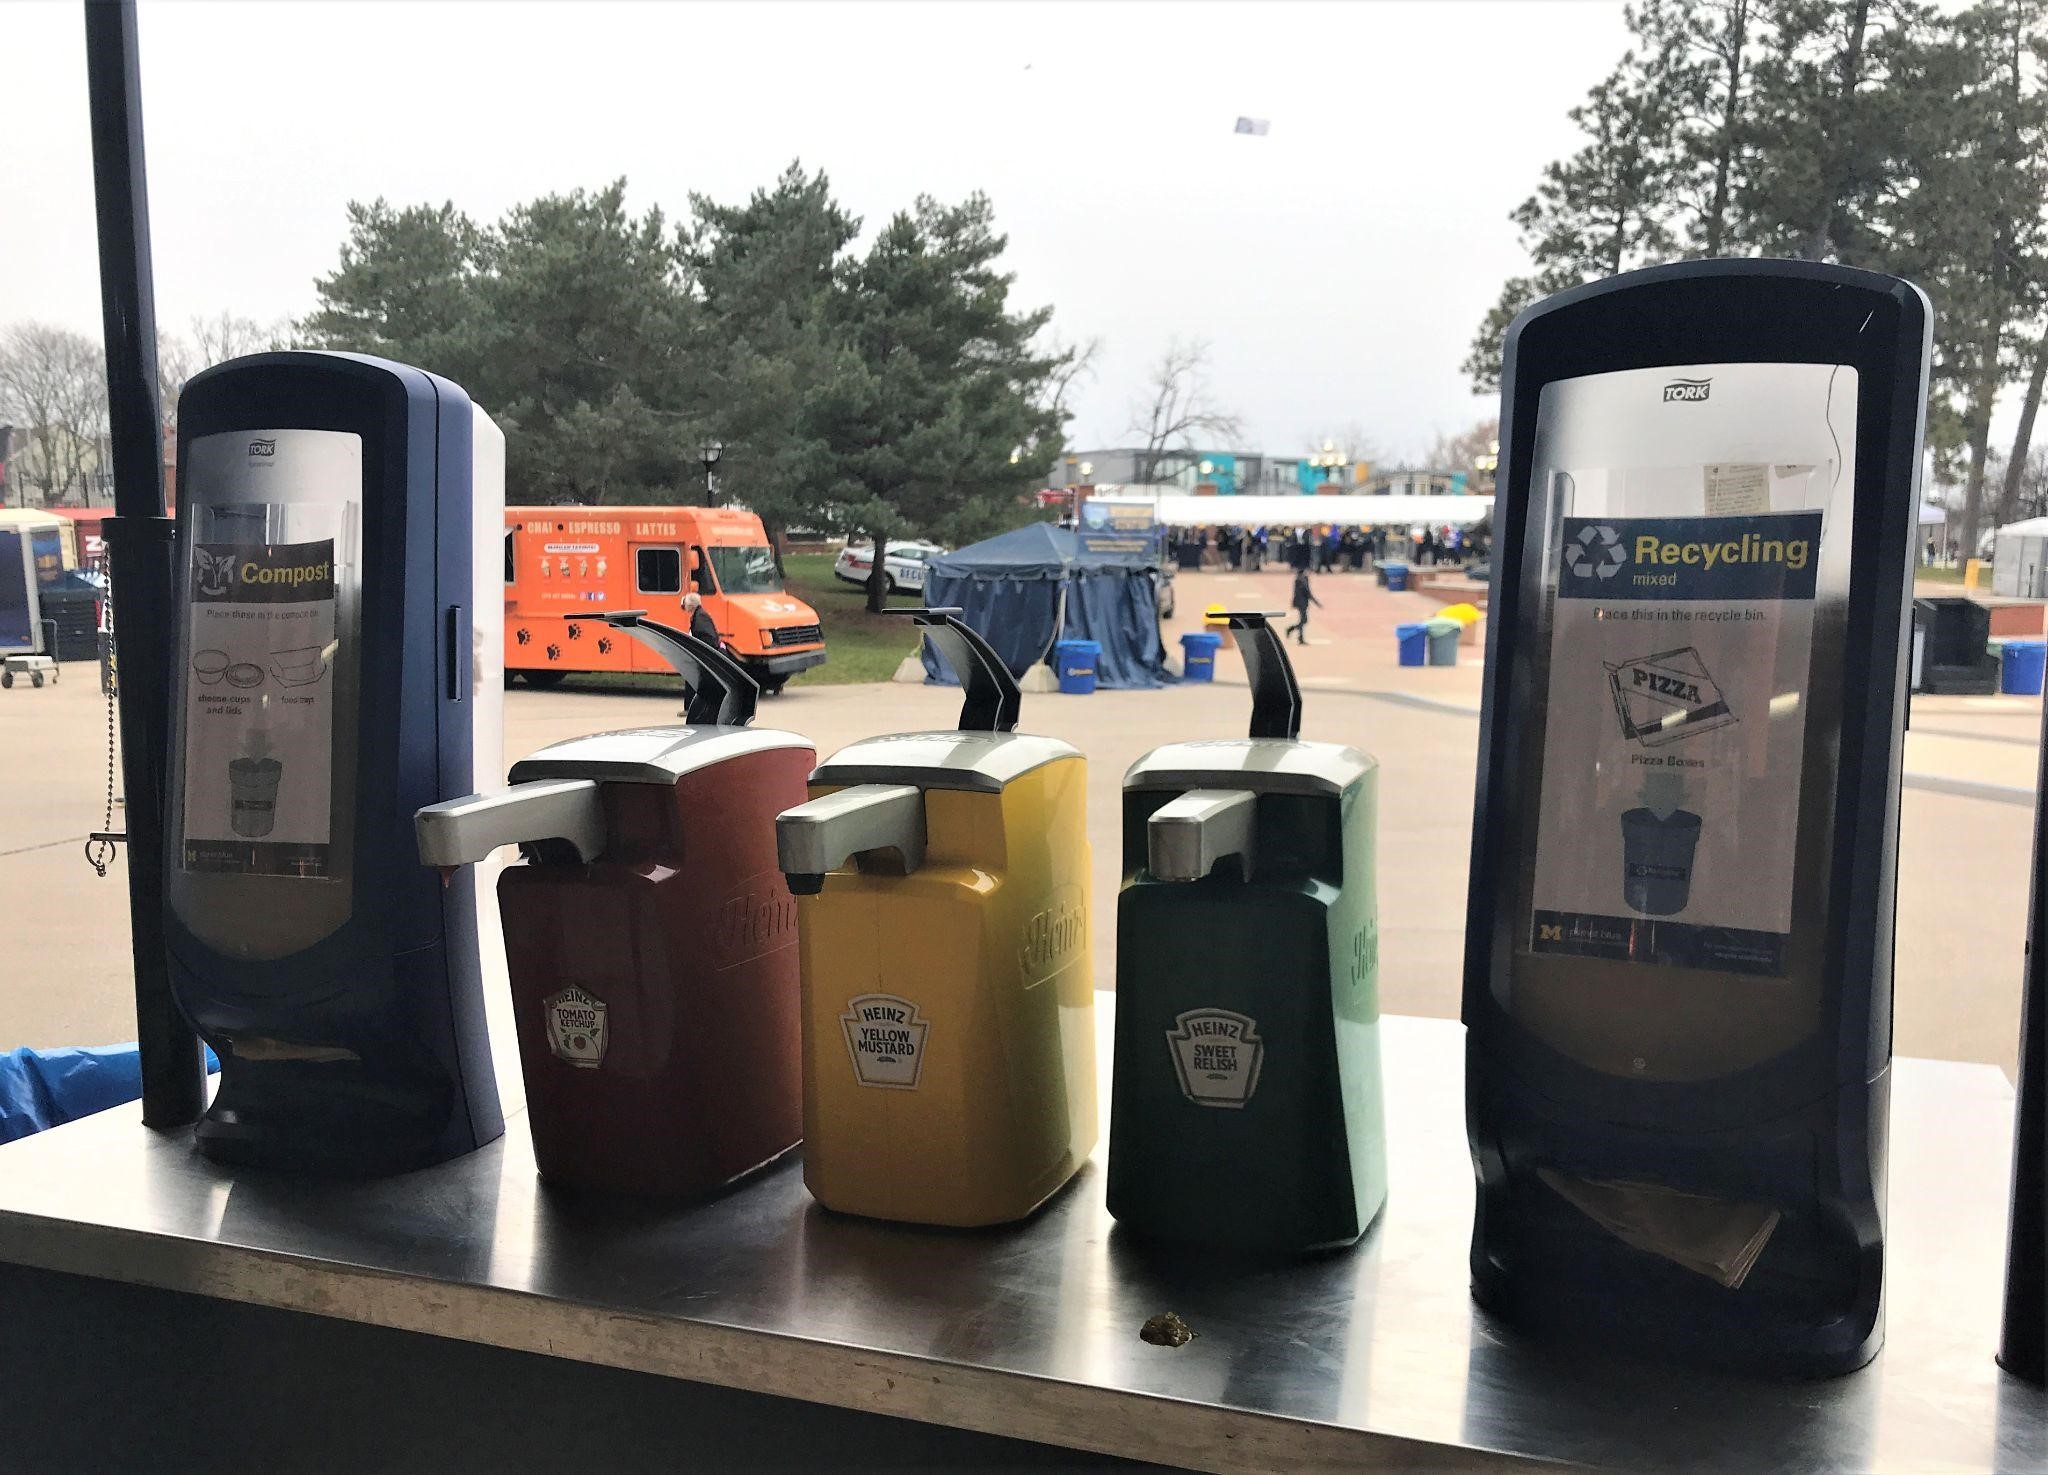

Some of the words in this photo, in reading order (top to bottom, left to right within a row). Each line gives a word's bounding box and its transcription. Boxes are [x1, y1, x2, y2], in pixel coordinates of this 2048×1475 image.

[1664, 383, 1710, 401] TORK
[250, 442, 276, 456] TORK
[527, 522, 552, 534] CHAI
[569, 521, 621, 535] ESPRESSO
[636, 522, 677, 536] LATTES
[1634, 533, 1808, 570] Recycling
[241, 560, 329, 587] Compost
[1633, 570, 1677, 586] mixed
[1594, 607, 1628, 620] Pace
[1632, 607, 1656, 620] this
[1657, 607, 1668, 620] in
[1672, 607, 1693, 620] the
[1695, 607, 1741, 621] recycle
[1633, 668, 1702, 704] PIZZA
[1631, 753, 1663, 766] Pizza
[557, 1008, 596, 1020] TOMATO
[863, 1006, 905, 1024] HEINZ
[560, 1019, 595, 1028] KETCHUP
[1192, 1021, 1239, 1038] HEINZ
[861, 1027, 910, 1042] YELLOW
[858, 1040, 915, 1056] MUSTARD
[1194, 1044, 1237, 1058] SWEET
[1193, 1056, 1239, 1072] RELISH
